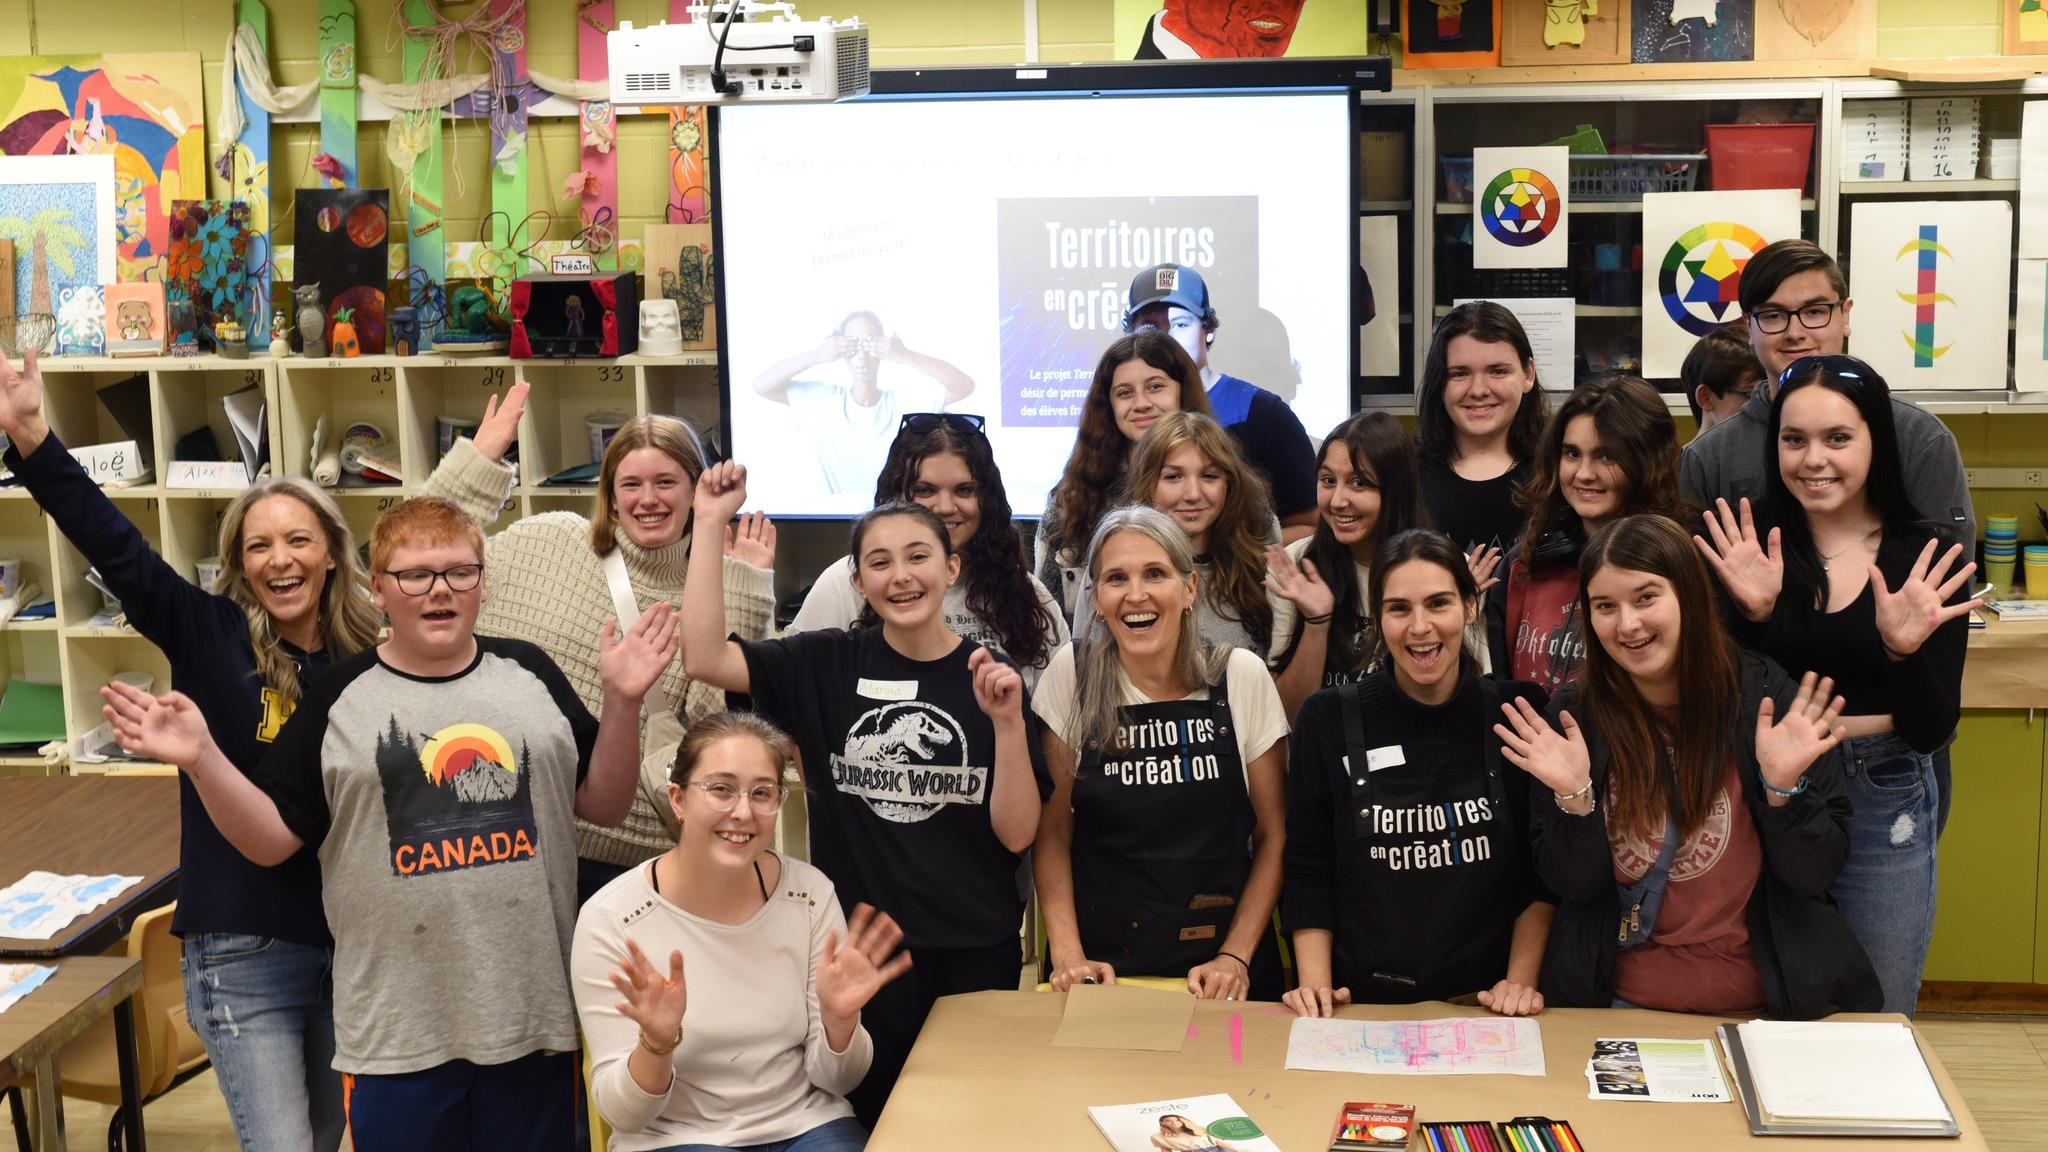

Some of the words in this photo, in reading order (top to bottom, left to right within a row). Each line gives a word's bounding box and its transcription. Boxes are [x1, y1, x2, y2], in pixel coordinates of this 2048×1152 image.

[1933, 162, 1953, 177] 16
[1159, 271, 1175, 280] BIG
[1043, 288, 1066, 312] en
[1068, 282, 1131, 331] crē
[371, 367, 393, 384] 25
[482, 366, 505, 387] 29
[598, 366, 624, 382] 33
[1029, 368, 1042, 380] Le
[1043, 368, 1072, 382] projet
[1020, 387, 1045, 398] désir
[1047, 387, 1059, 398] de
[1020, 405, 1038, 416] des
[1039, 405, 1069, 416] élèves
[77, 451, 124, 476] hloë
[1115, 719, 1215, 749] erritoires
[1104, 761, 1119, 776] en
[834, 761, 904, 793] JURASSIC
[907, 769, 982, 797] WORLD
[1372, 797, 1493, 834] Territoires
[395, 829, 536, 874] CANADA
[1370, 846, 1387, 859] en
